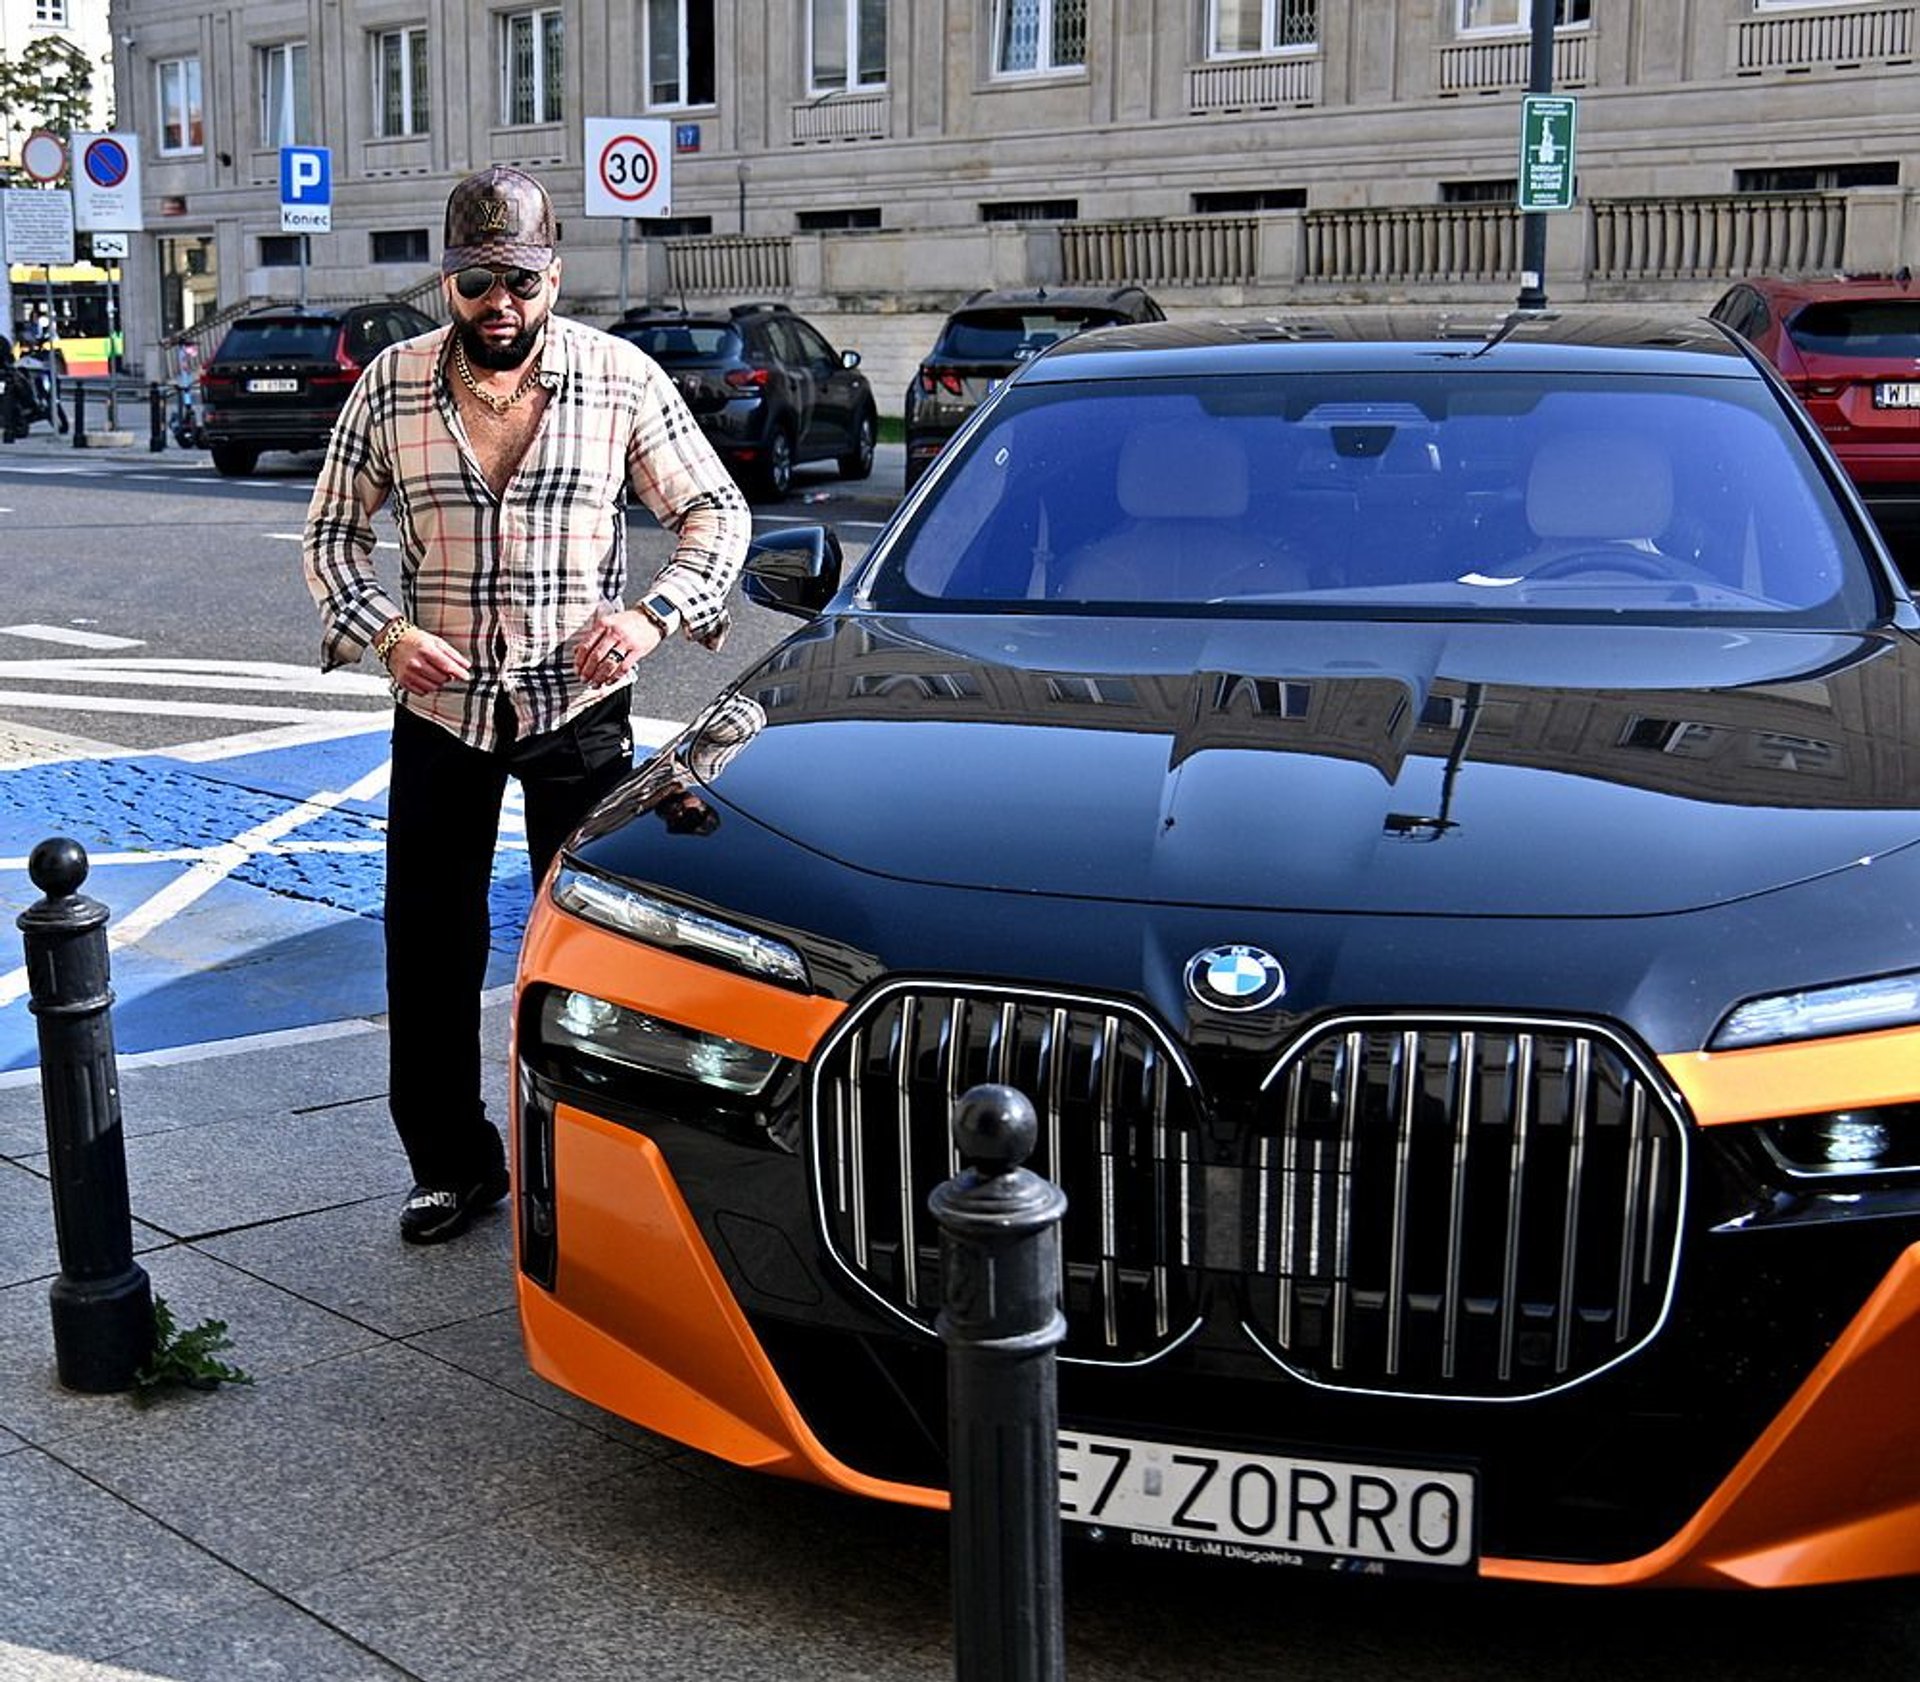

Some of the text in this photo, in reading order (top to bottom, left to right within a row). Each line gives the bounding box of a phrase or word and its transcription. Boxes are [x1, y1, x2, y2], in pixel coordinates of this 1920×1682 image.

[291, 153, 321, 199] P
[608, 153, 650, 184] 30
[284, 211, 328, 226] Koniec
[1200, 946, 1279, 969] BMW
[1172, 1454, 1459, 1557] ZORRO
[1131, 1532, 1172, 1549] BMW
[1175, 1538, 1221, 1556] TEAM
